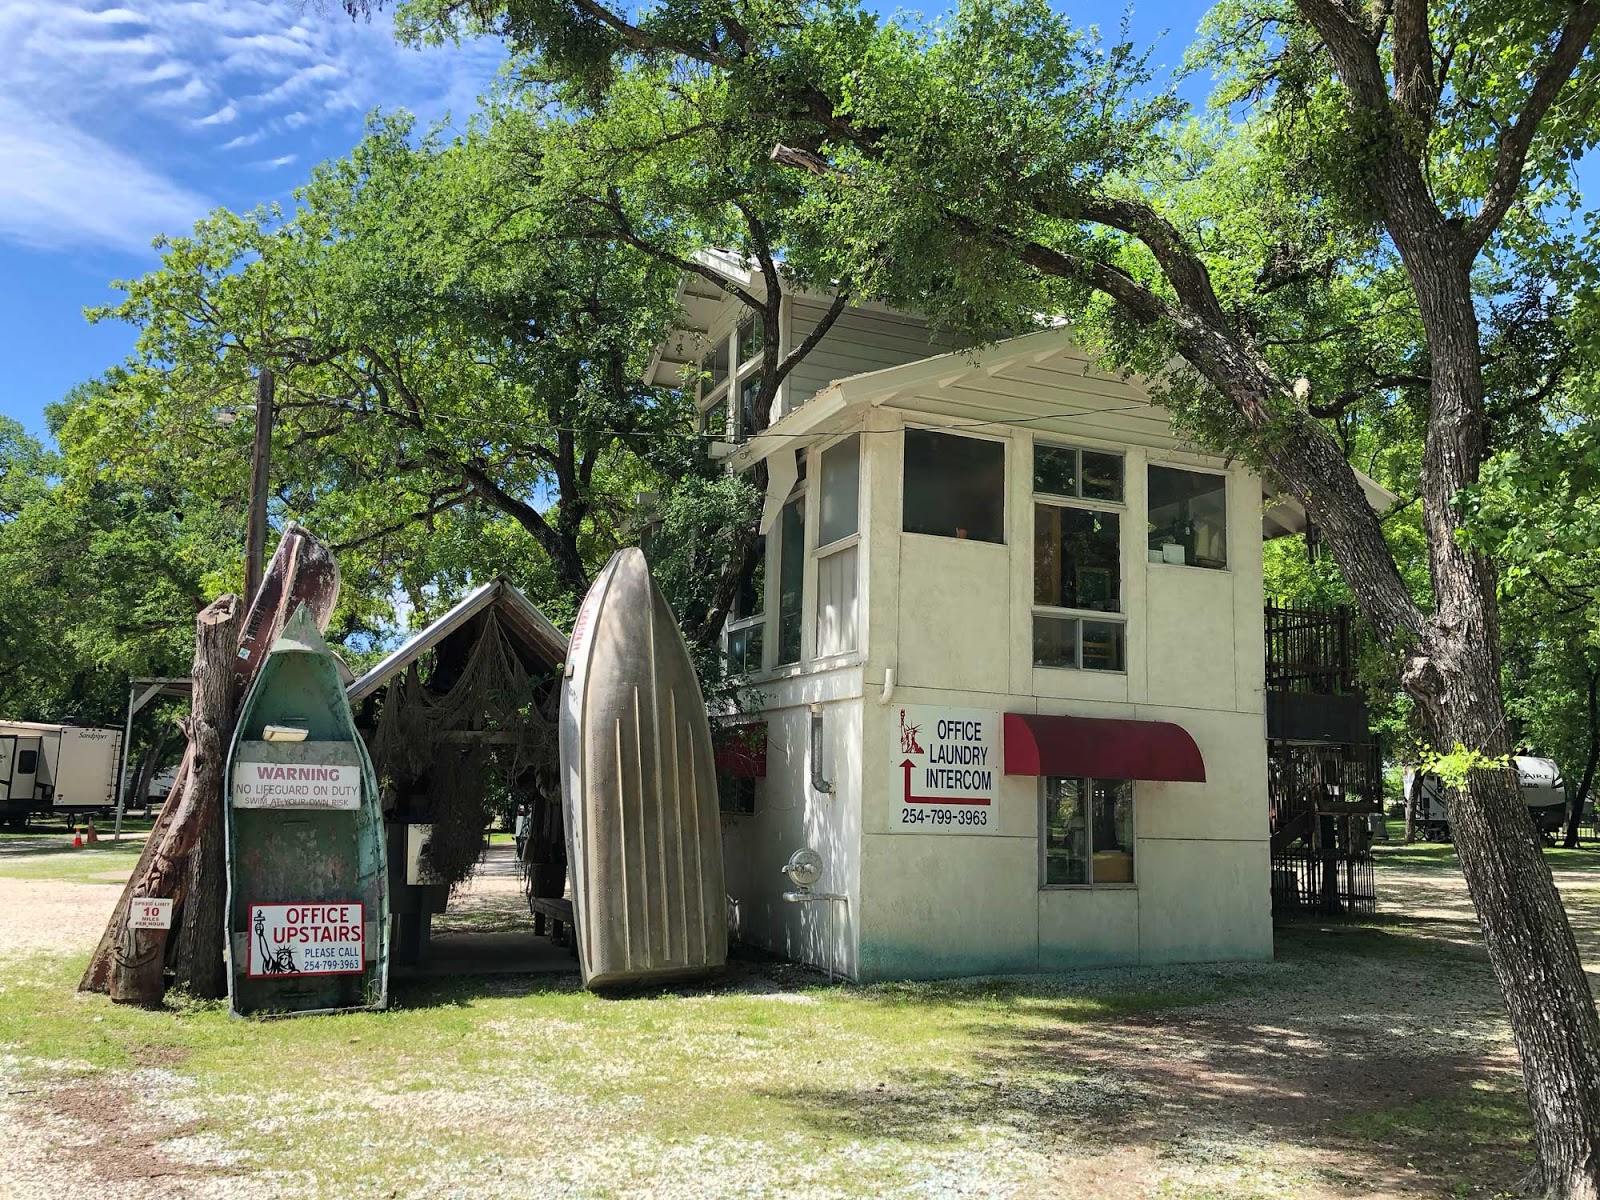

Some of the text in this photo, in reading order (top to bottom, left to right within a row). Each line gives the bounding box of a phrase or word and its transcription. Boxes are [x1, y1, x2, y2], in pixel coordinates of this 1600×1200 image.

[78, 731, 109, 741] Sandpiper
[937, 719, 982, 741] OFFICE
[929, 743, 988, 766] LAUNDRY
[257, 766, 340, 781] WARNING
[926, 768, 992, 790] INTERCOM
[236, 784, 358, 797] NO LIFEGUARD ON DUTY
[244, 797, 349, 807] SWIM AT YOUR OWN RISK
[902, 808, 987, 825] 254-799-3963
[143, 907, 160, 917] 10
[286, 907, 349, 924] OFFICE
[273, 925, 361, 944] UPSTAIRS
[304, 947, 359, 958] PLEASE CALL
[303, 959, 359, 971] 254-799-3963
